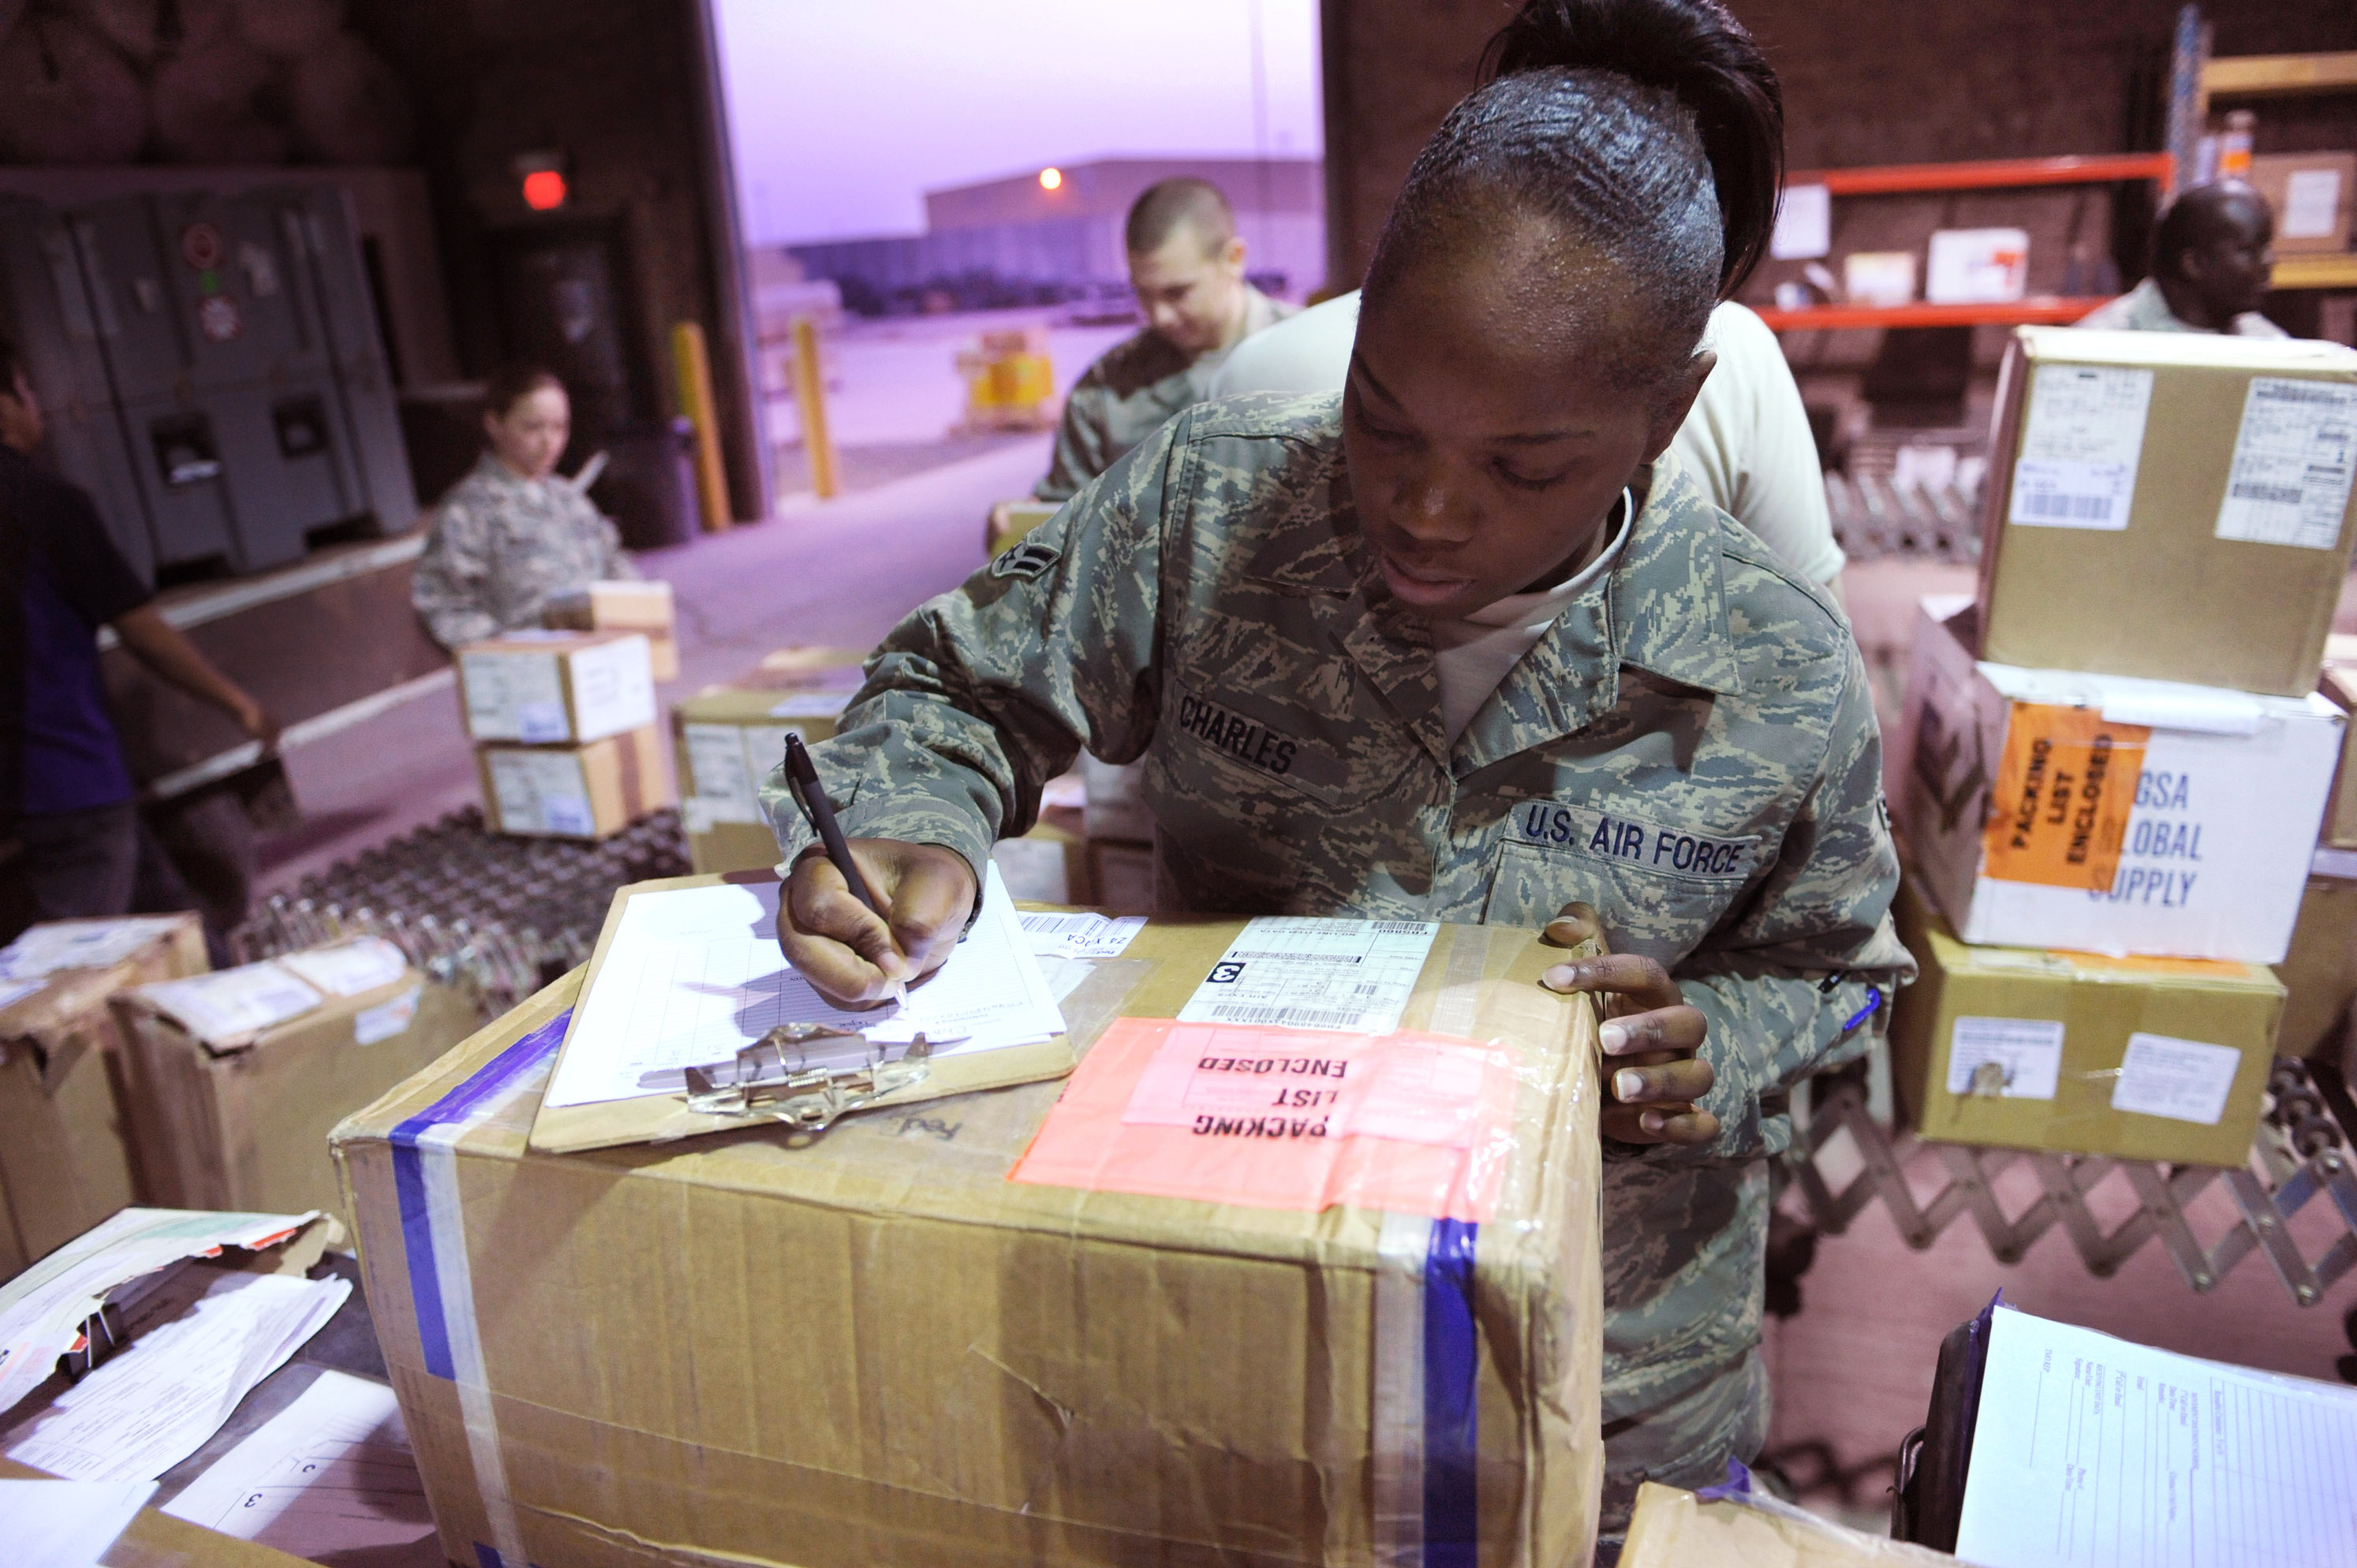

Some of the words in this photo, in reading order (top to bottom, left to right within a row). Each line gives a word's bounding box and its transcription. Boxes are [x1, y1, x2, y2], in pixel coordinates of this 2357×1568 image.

[1180, 695, 1297, 775] CHARLES
[2011, 737, 2052, 849] PACKING
[2047, 768, 2075, 824] LIST
[2066, 734, 2113, 865] ENCLOSED
[2135, 769, 2190, 809] GSA
[1526, 805, 1575, 846] U.S.
[1589, 816, 1645, 861] AIR
[1653, 831, 1746, 874] FORCE
[2101, 816, 2202, 861] OBAL
[1212, 965, 1240, 981] 3
[1197, 1058, 1348, 1079] ENCLOSED
[1271, 1088, 1339, 1107] LIST
[1192, 1114, 1329, 1137] PACKING
